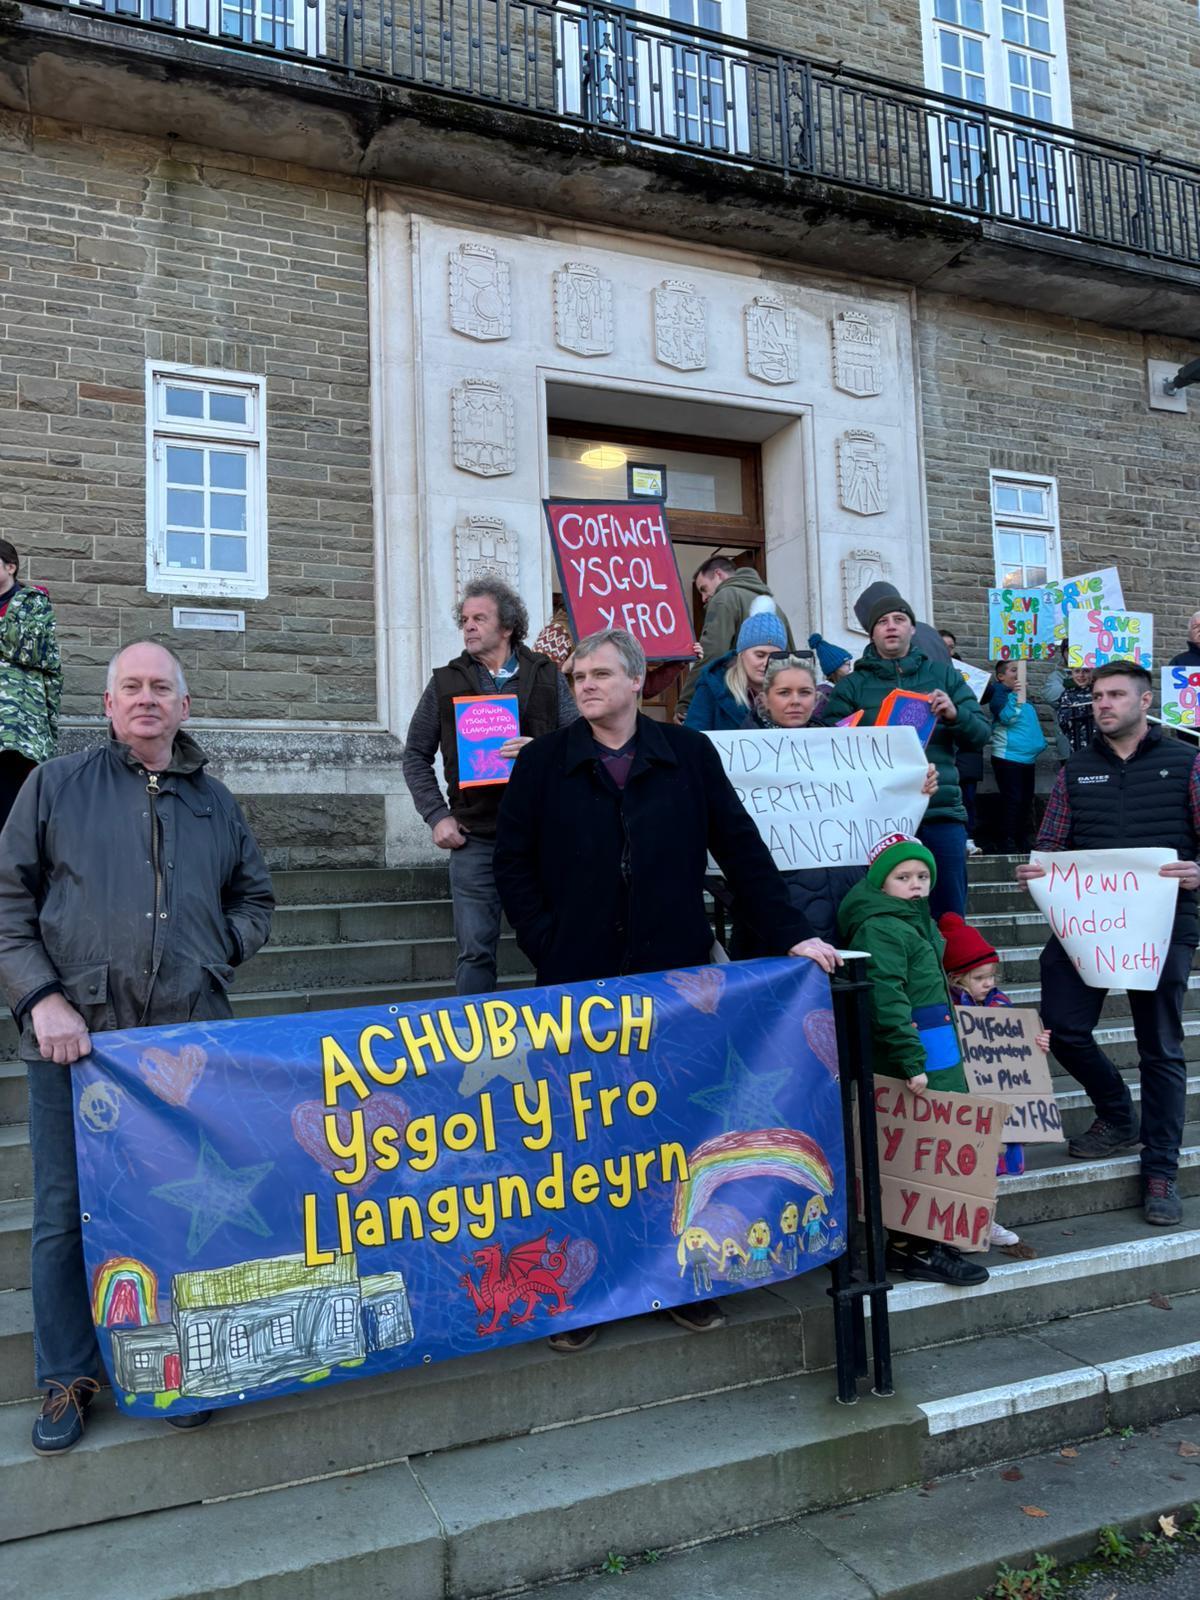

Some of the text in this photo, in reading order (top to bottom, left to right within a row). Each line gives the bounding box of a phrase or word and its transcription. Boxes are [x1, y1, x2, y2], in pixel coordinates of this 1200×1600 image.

[558, 513, 668, 550] COFIWCH
[570, 556, 668, 598] YSGOL
[1045, 576, 1102, 605] Save
[1002, 589, 1040, 613] Save
[597, 602, 676, 638] Y FRO
[999, 611, 1038, 643] Ysgol
[1087, 610, 1141, 634] Save
[1068, 645, 1152, 668] Schools
[1097, 629, 1140, 653] Our
[868, 777, 879, 803] I
[1049, 862, 1139, 901] Mewn
[1049, 905, 1127, 939] Undod
[1095, 942, 1160, 976] Nerth
[319, 995, 654, 1107] ACHUBWCH
[323, 1091, 498, 1186] Ysgol
[569, 1070, 658, 1142] Fro
[873, 1087, 993, 1135] CADWCH
[881, 1126, 904, 1162] Y
[304, 1140, 690, 1268] Llangyndeyrn
[900, 1188, 921, 1226] Y
[927, 1197, 990, 1246] MAP
